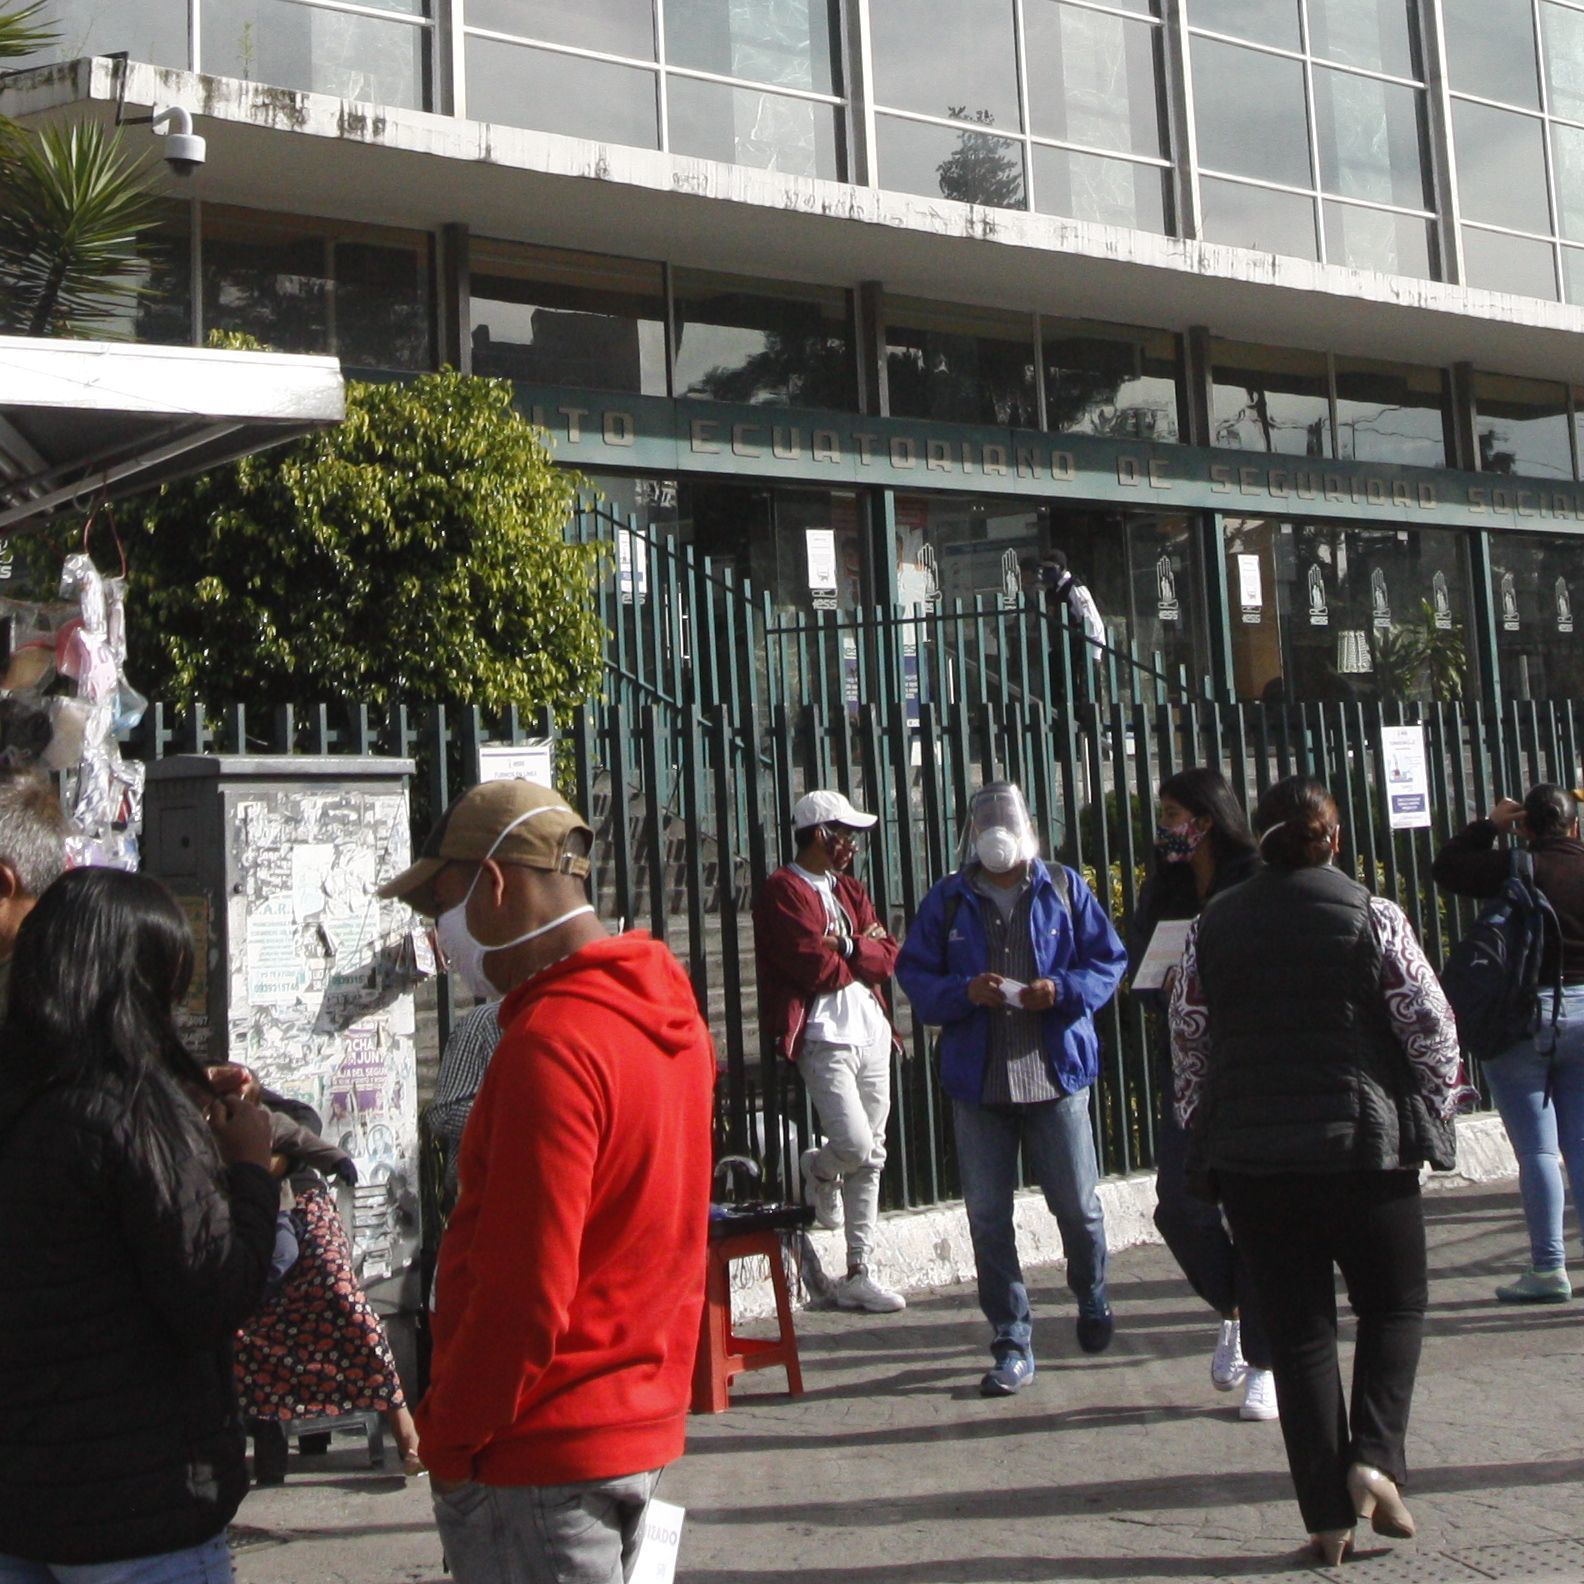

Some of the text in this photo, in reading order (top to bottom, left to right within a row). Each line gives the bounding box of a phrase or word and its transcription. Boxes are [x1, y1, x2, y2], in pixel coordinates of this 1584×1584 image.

[690, 418, 1076, 482] ECUATORIANO
[1117, 454, 1173, 490] DE
[1210, 463, 1438, 510] SEGURIDAD
